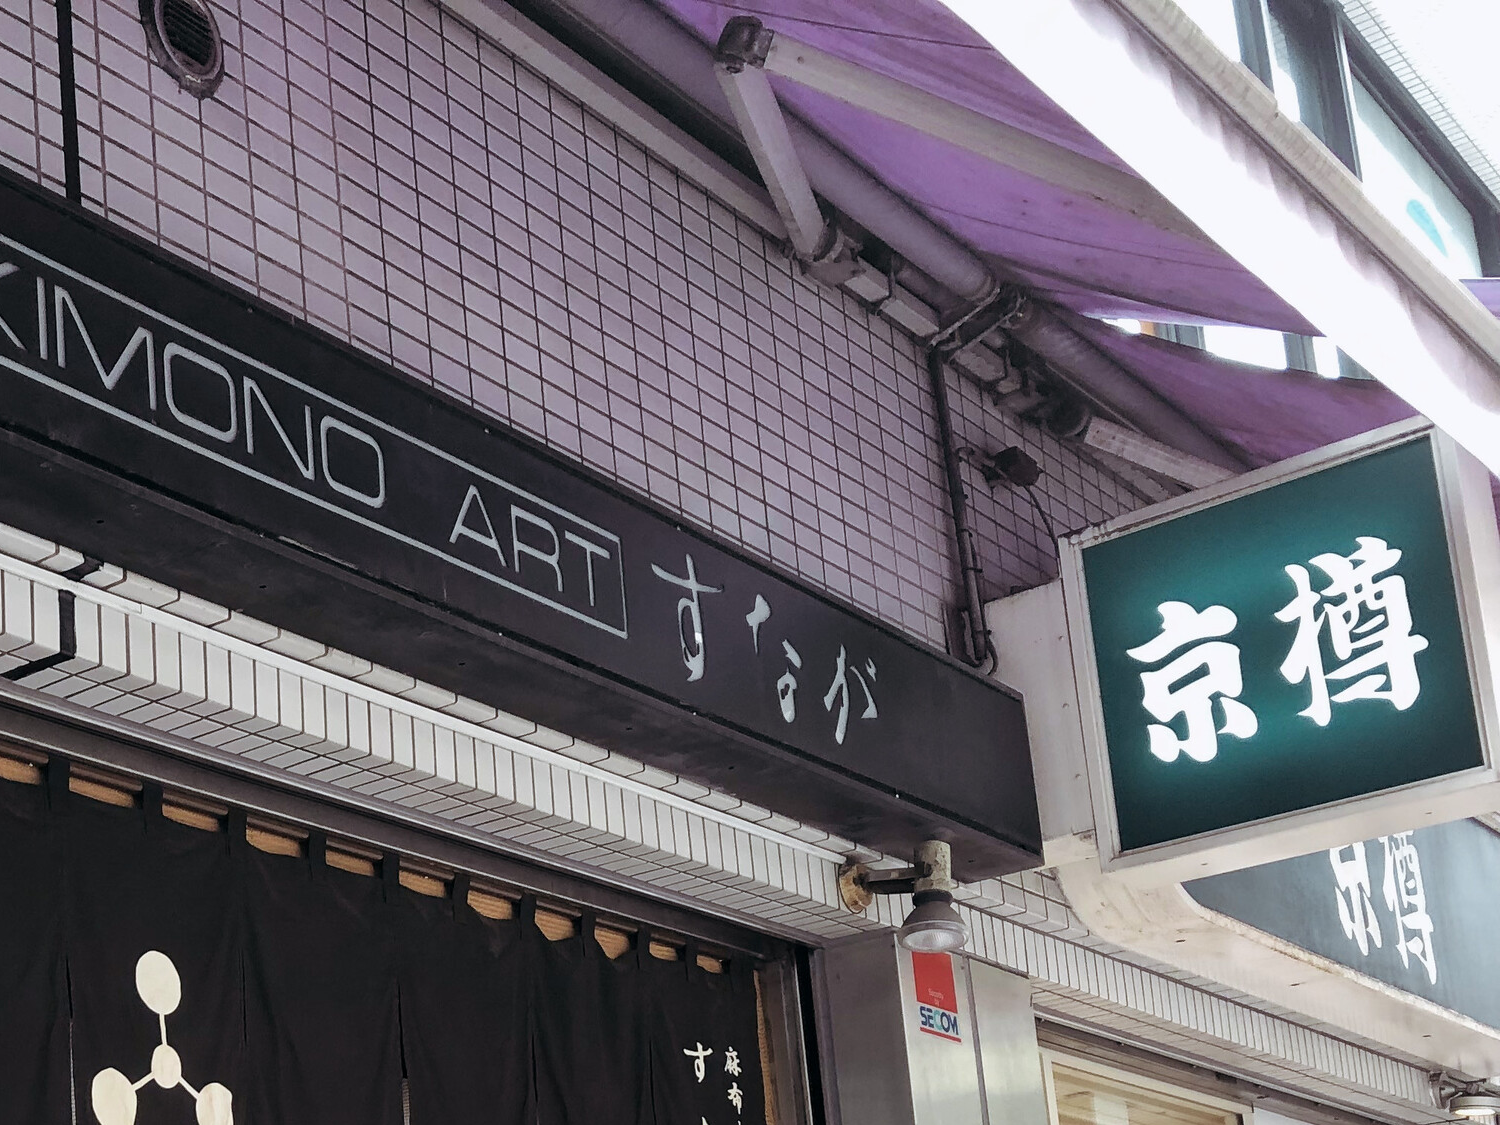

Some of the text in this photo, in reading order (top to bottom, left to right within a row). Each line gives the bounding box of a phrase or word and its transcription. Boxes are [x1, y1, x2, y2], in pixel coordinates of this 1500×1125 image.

[450, 484, 611, 607] ART
[651, 553, 878, 745] すなが
[1126, 536, 1430, 763] 京樽
[919, 1005, 959, 1036] SECOM
